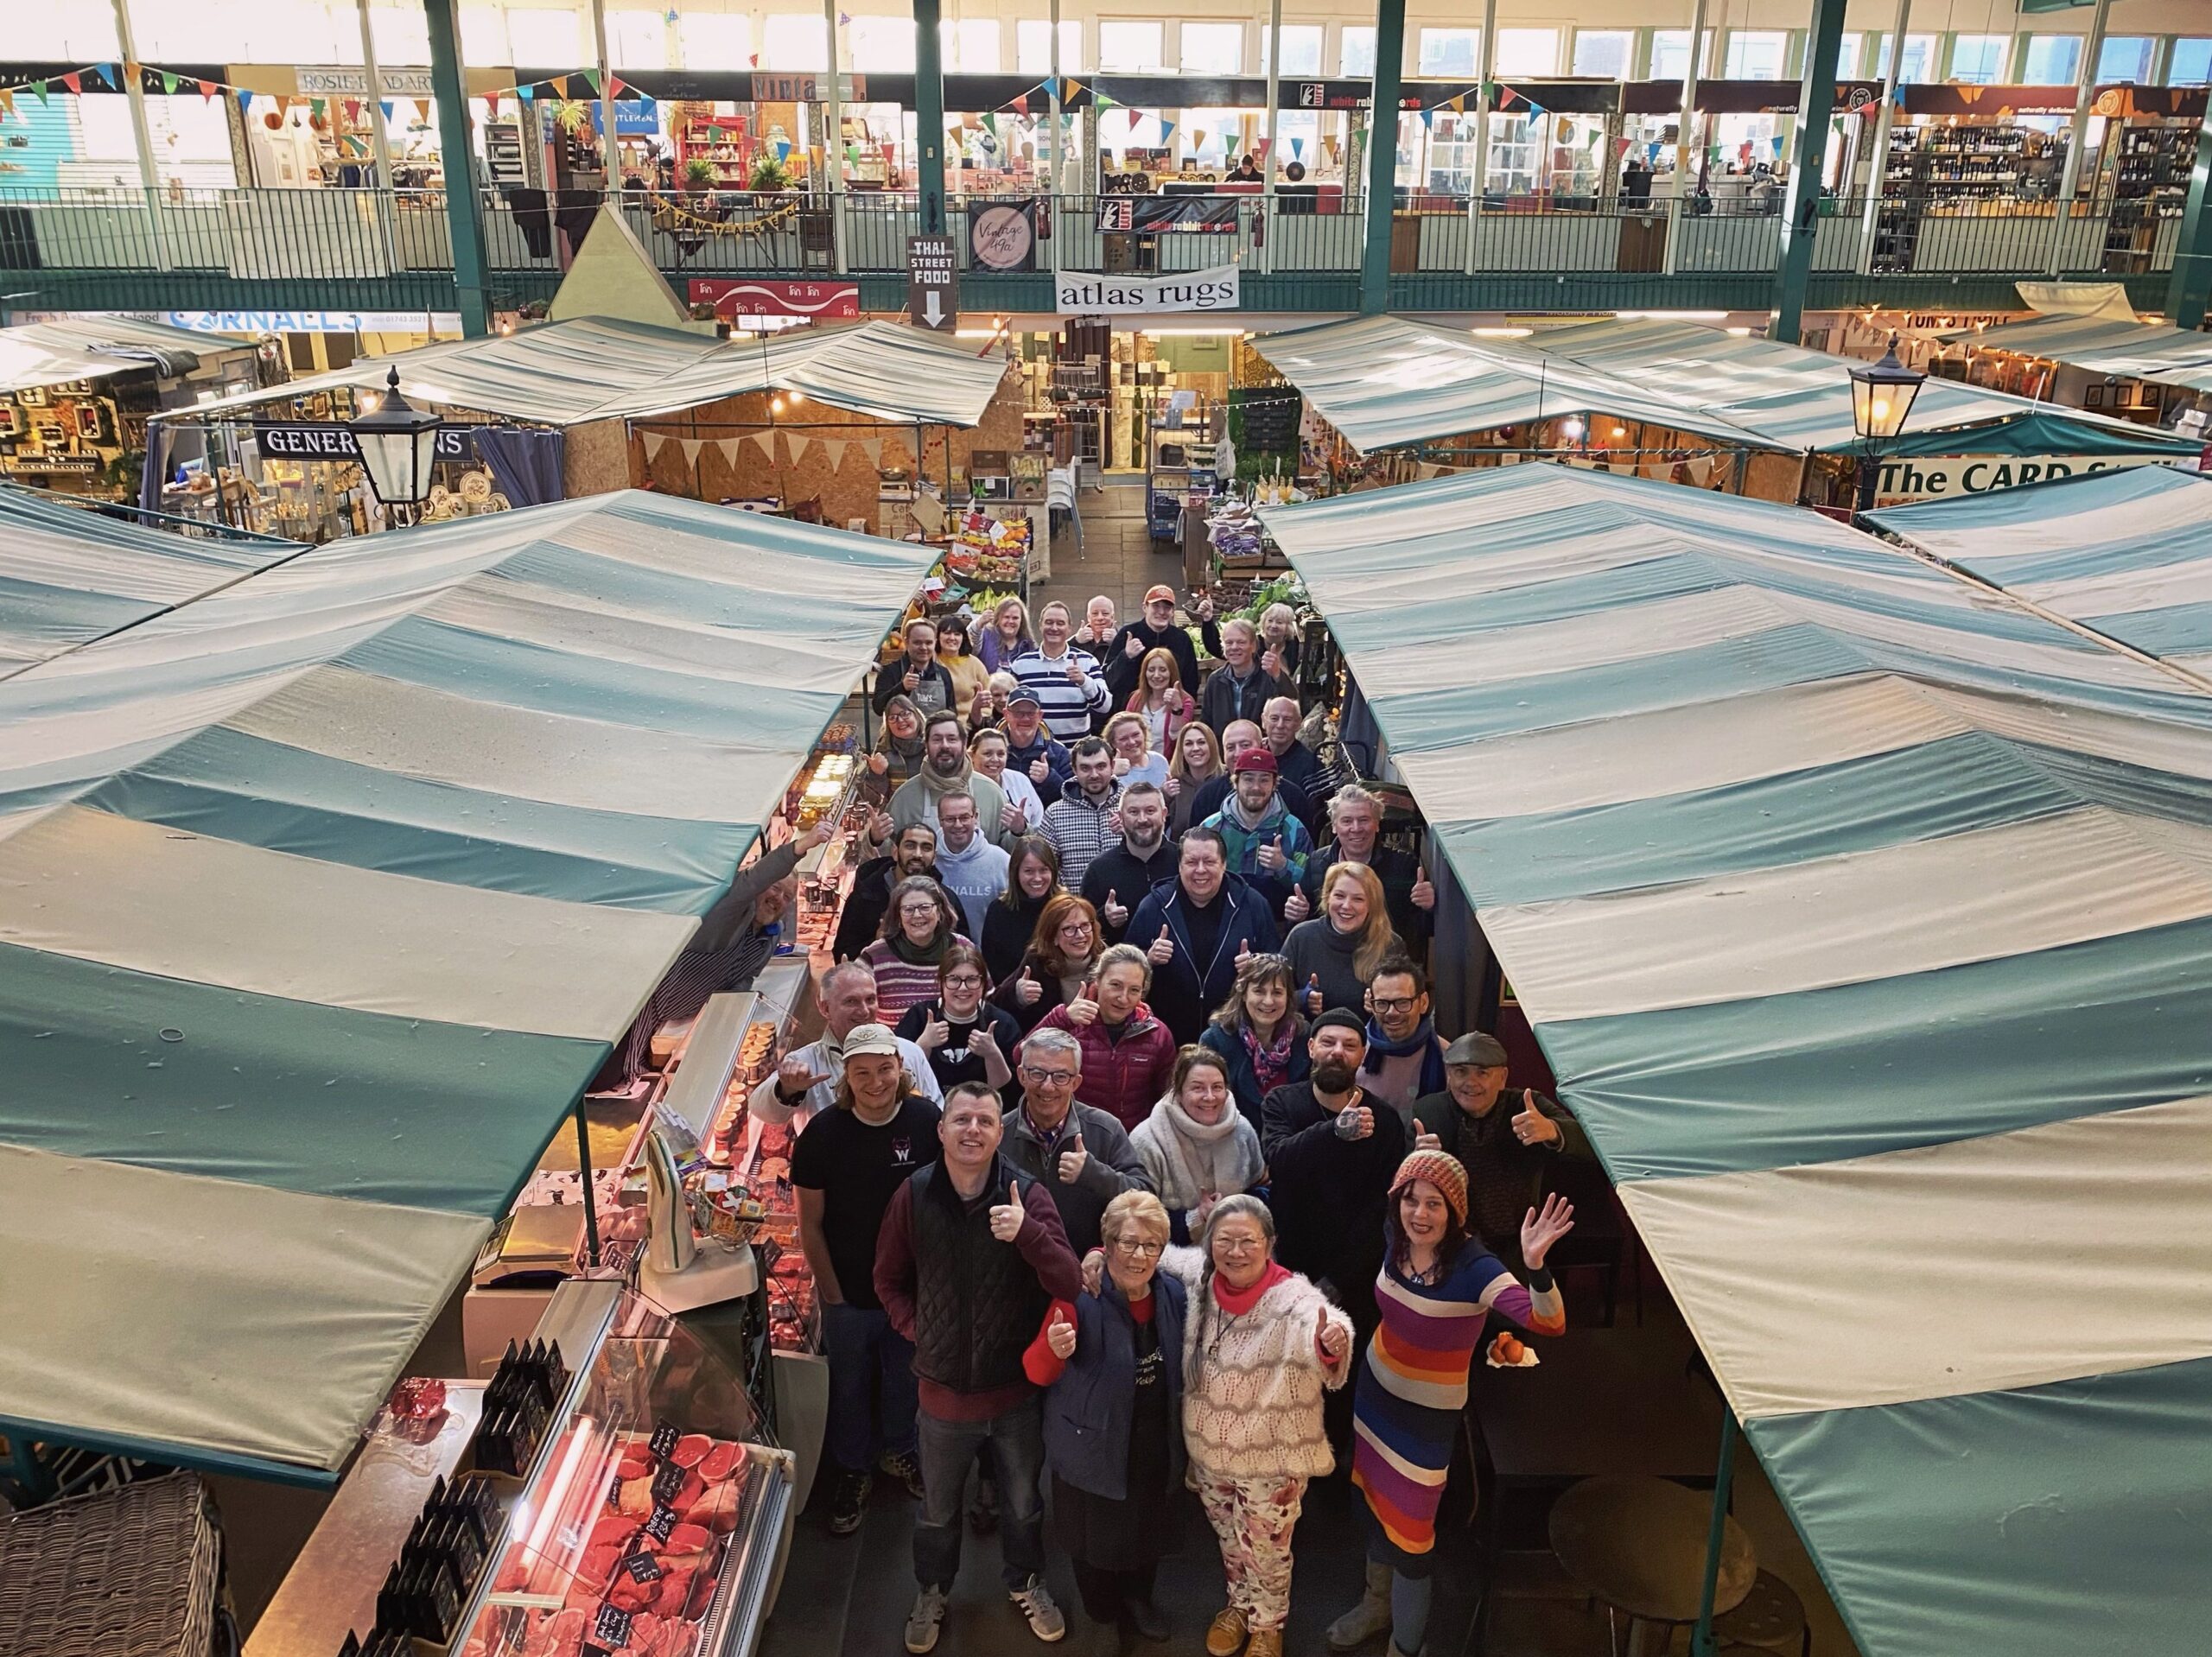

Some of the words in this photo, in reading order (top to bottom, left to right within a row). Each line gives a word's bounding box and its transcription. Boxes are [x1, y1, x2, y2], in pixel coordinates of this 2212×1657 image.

[303, 74, 353, 89] ROSIE
[358, 76, 404, 90] RAD
[2018, 106, 2048, 115] naturally
[979, 221, 1024, 243] Vintage
[914, 241, 946, 256] THAI
[991, 238, 1014, 253] 49a
[911, 257, 953, 268] STREET
[914, 270, 950, 284] FOOD
[1061, 282, 1145, 306] atlas
[1157, 281, 1235, 308] rugs
[1876, 463, 1948, 493] The
[646, 1506, 664, 1534] RIBEYE
